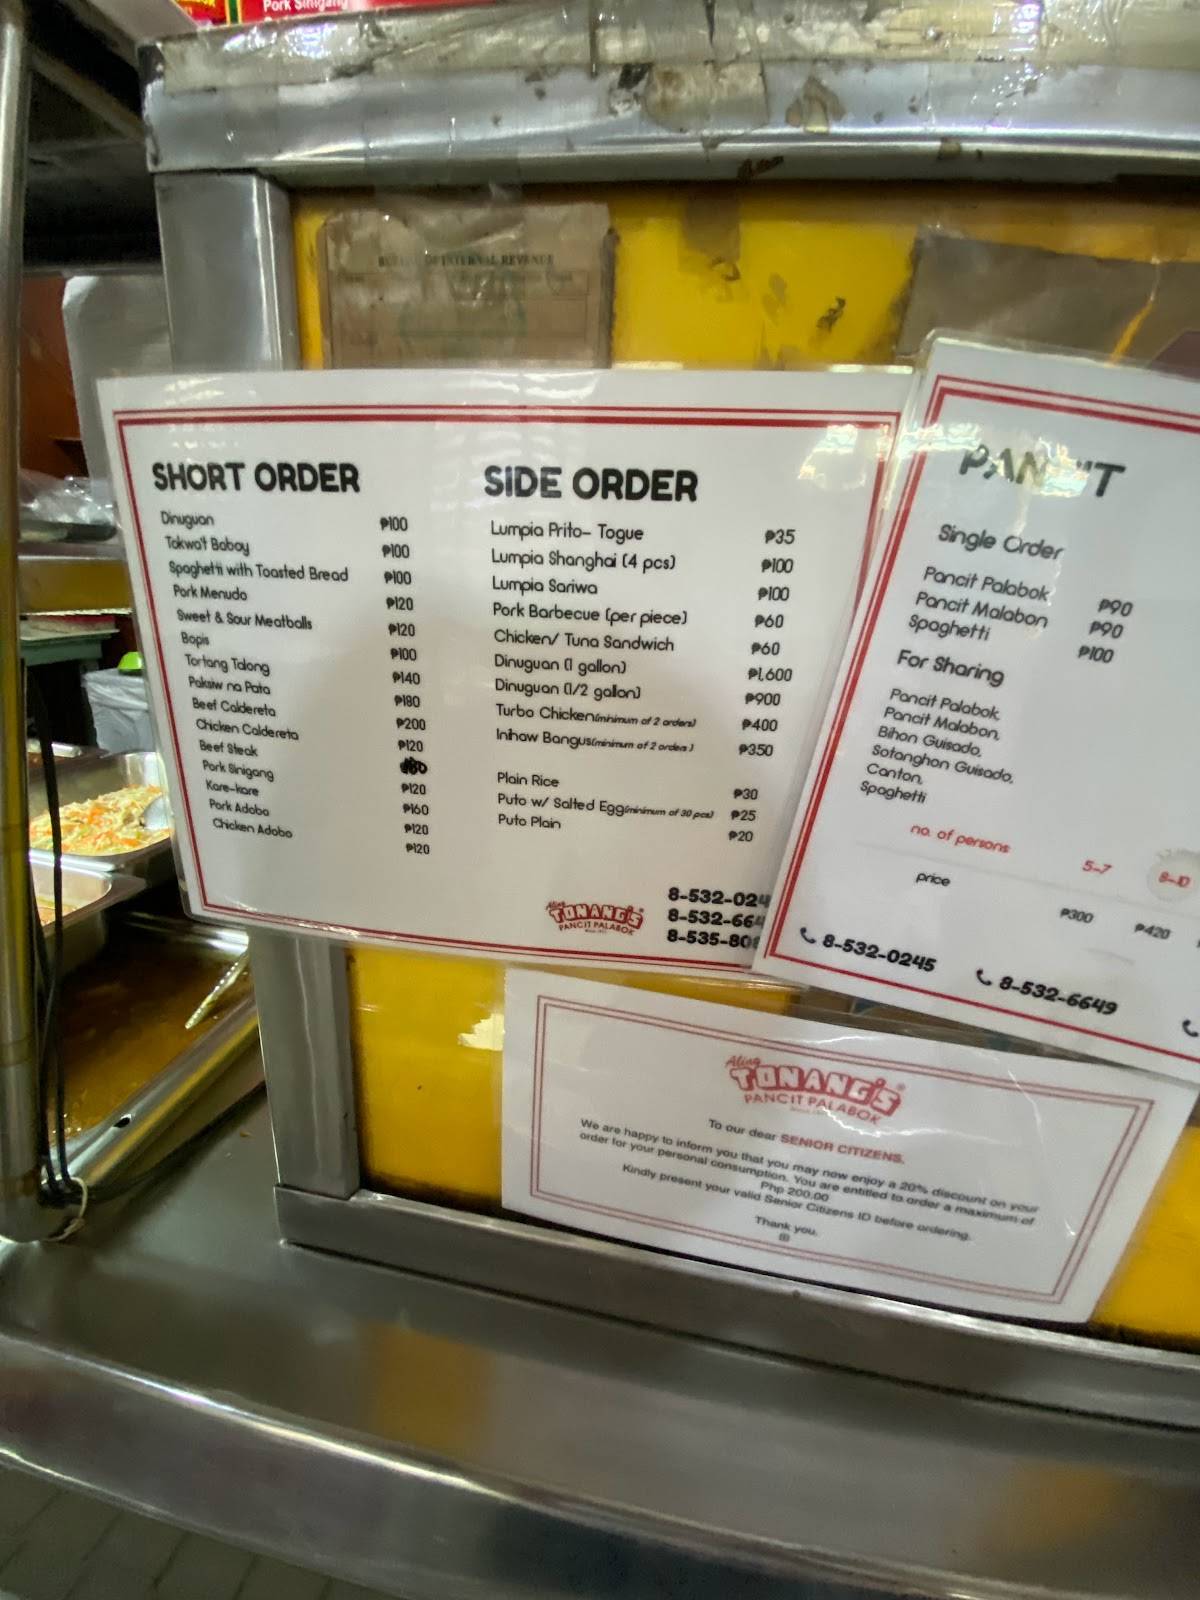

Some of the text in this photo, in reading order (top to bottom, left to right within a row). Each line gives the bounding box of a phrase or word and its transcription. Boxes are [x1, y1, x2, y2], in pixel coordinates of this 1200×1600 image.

[152, 462, 361, 493] SHORT ORDER
[959, 444, 1127, 498] PANT
[484, 466, 699, 502] SIDE ORDER
[161, 510, 214, 529] Dinuguan
[490, 520, 544, 541] Lumpia
[597, 523, 644, 545] Togue
[938, 524, 1064, 560] Single Order
[211, 536, 250, 556] Baboy
[169, 560, 223, 579] Spaghetti
[226, 562, 253, 576] with
[255, 564, 304, 580] Toasted
[309, 566, 349, 581] Bread
[491, 548, 544, 568] Lumpia
[549, 550, 617, 571] Shanghai
[622, 553, 637, 569] (4
[643, 555, 676, 574] pcs)
[173, 584, 248, 601] Pork Menudo
[492, 576, 544, 596] Lumpia
[549, 578, 598, 595] Sariwa
[923, 566, 978, 591] Pancit
[981, 576, 1050, 602] Palabok
[177, 608, 211, 623] Sweet
[215, 611, 223, 624] &
[226, 612, 252, 626] Sour
[255, 614, 313, 630] Meatballs
[493, 602, 525, 618] Pork
[529, 604, 600, 622] Barbecue
[605, 607, 636, 625] (per
[640, 610, 688, 626] piece)
[915, 591, 969, 615] Pancit
[972, 601, 1048, 628] Malabon
[908, 614, 991, 641] Spaghetti
[181, 631, 210, 648] Bopis
[494, 629, 559, 646] Chicken/
[564, 632, 600, 648] Tuna
[603, 635, 675, 652] Sandwich
[184, 653, 229, 673] Tortang
[231, 657, 271, 677] Talong
[494, 654, 560, 675] Dinuguan
[578, 658, 626, 676] gallon)
[897, 649, 1004, 688] For Sharing
[188, 676, 271, 695] Paksiw na Pata
[495, 678, 560, 699] Dinuguan
[563, 682, 589, 698] (1/2
[594, 684, 641, 701] gallon)
[192, 697, 217, 711] Beef
[220, 699, 276, 717] Caldereta
[890, 688, 937, 708] Pancit
[496, 703, 534, 718] Turbo
[196, 718, 299, 740] Chicken Caldereta
[496, 728, 539, 742] Inihaw
[878, 725, 918, 744] Bihon
[884, 706, 1000, 741] Pancit Malabon,
[199, 739, 258, 757] Beef Steak
[202, 759, 275, 782] Pork Sinigang
[872, 744, 1014, 784] Sotanghon Guisado,
[206, 779, 259, 796] Kare-kare
[497, 771, 528, 786] Plain
[532, 774, 559, 788] Rice
[497, 793, 527, 808] Puto
[532, 795, 547, 808] w/
[553, 797, 595, 812] Salted
[860, 780, 927, 803] Spaghetti
[209, 798, 270, 817] Pork Adobo
[213, 817, 255, 833] Chicken
[257, 823, 293, 839] Adobo
[498, 813, 527, 828] Puto
[531, 816, 561, 830] Plain
[910, 824, 931, 838] no.
[937, 827, 953, 841] of
[954, 833, 1010, 854] persons
[1082, 860, 1112, 875] 5-7
[915, 871, 951, 888] price
[668, 887, 771, 908] 8-532-024
[822, 933, 937, 973] 8-532-0245
[998, 976, 1118, 1017] 8-532-6649
[730, 1064, 902, 1117] TONANG'S
[743, 1093, 802, 1105] PANCIT
[808, 1094, 882, 1125] PALABOK
[748, 1127, 777, 1142] dear
[780, 1133, 834, 1152] SENIOR
[580, 1118, 885, 1189] We happy inform you may enjoy
[580, 1131, 888, 1201] order personal consumption. You entitled
[622, 1164, 656, 1180] Kindly
[659, 1173, 702, 1190] present
[705, 1182, 731, 1195] your
[734, 1187, 761, 1201] valid
[806, 1202, 854, 1220] Citizens
[760, 1181, 829, 1203] Php 200.00
[755, 1215, 818, 1237] Thank you.
